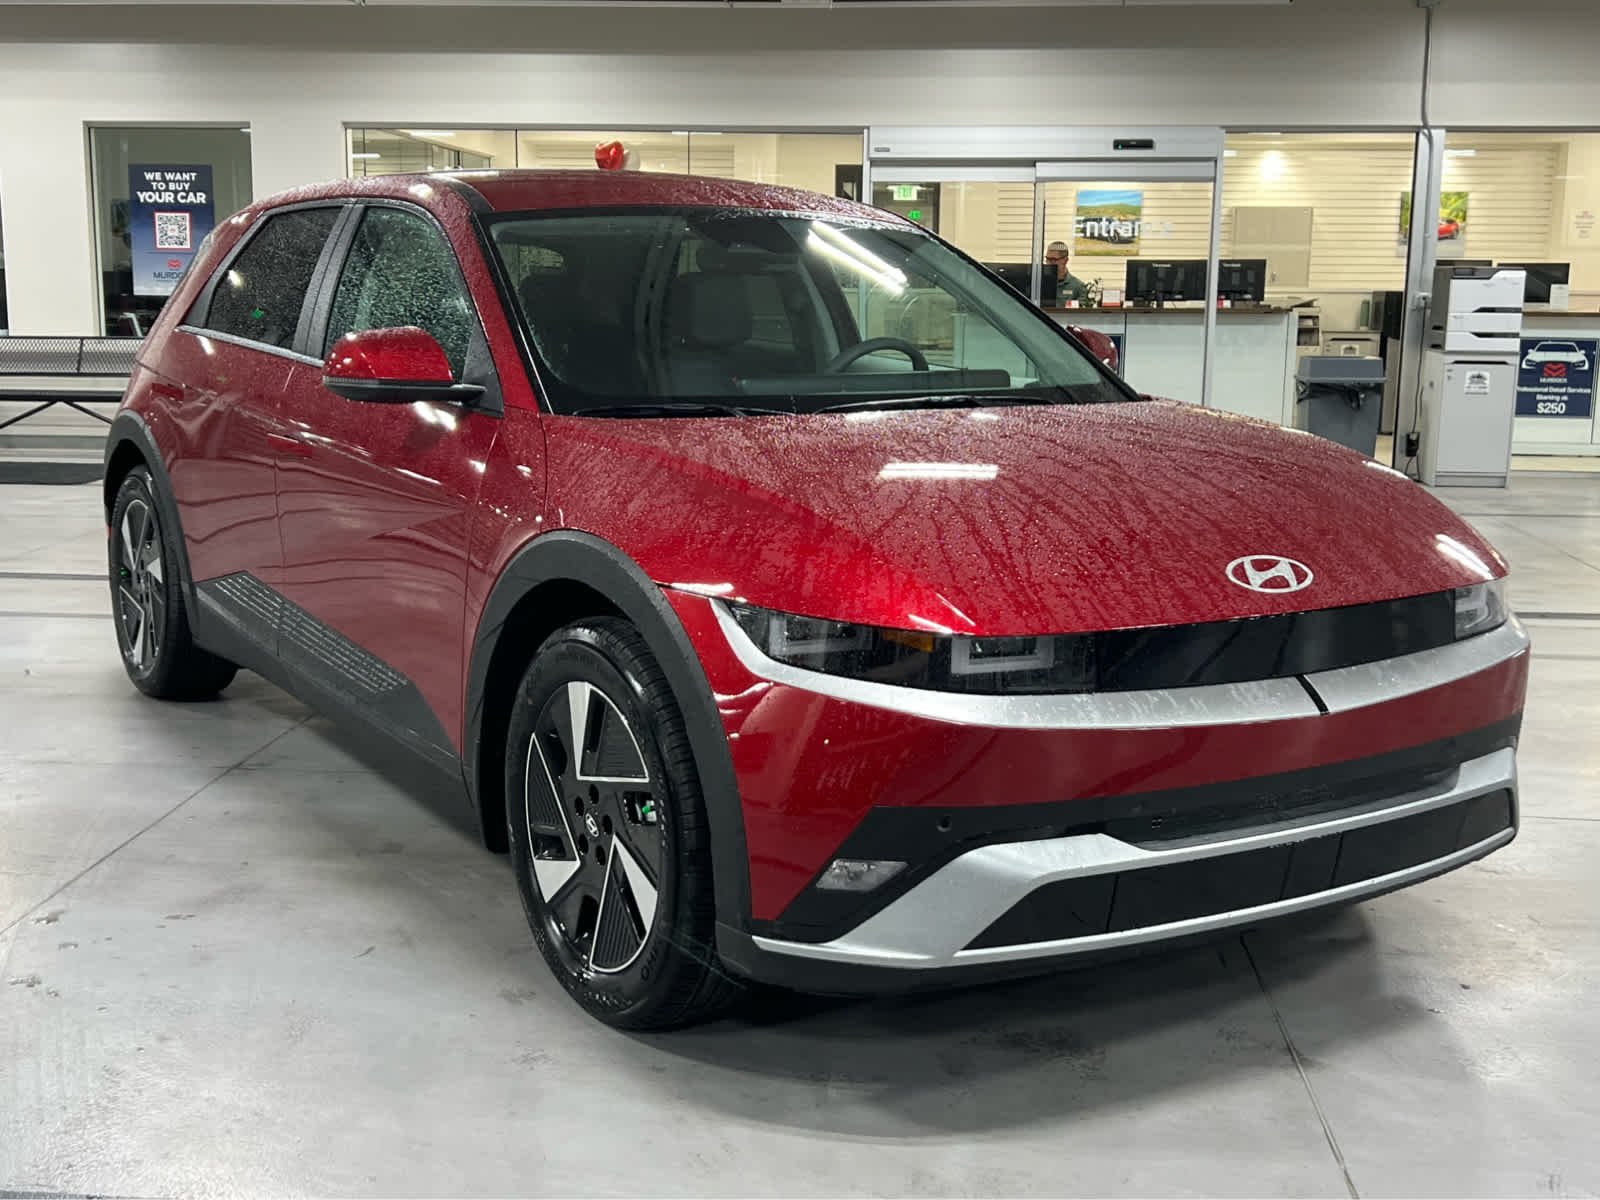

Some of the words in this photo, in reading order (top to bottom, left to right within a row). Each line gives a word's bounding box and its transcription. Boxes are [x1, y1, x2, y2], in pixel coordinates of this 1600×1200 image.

[144, 172, 162, 181] WE
[164, 172, 197, 181] WANT
[151, 182, 166, 190] TO
[168, 182, 190, 191] BUY
[136, 191, 175, 203] YOUR
[176, 192, 207, 203] CAR
